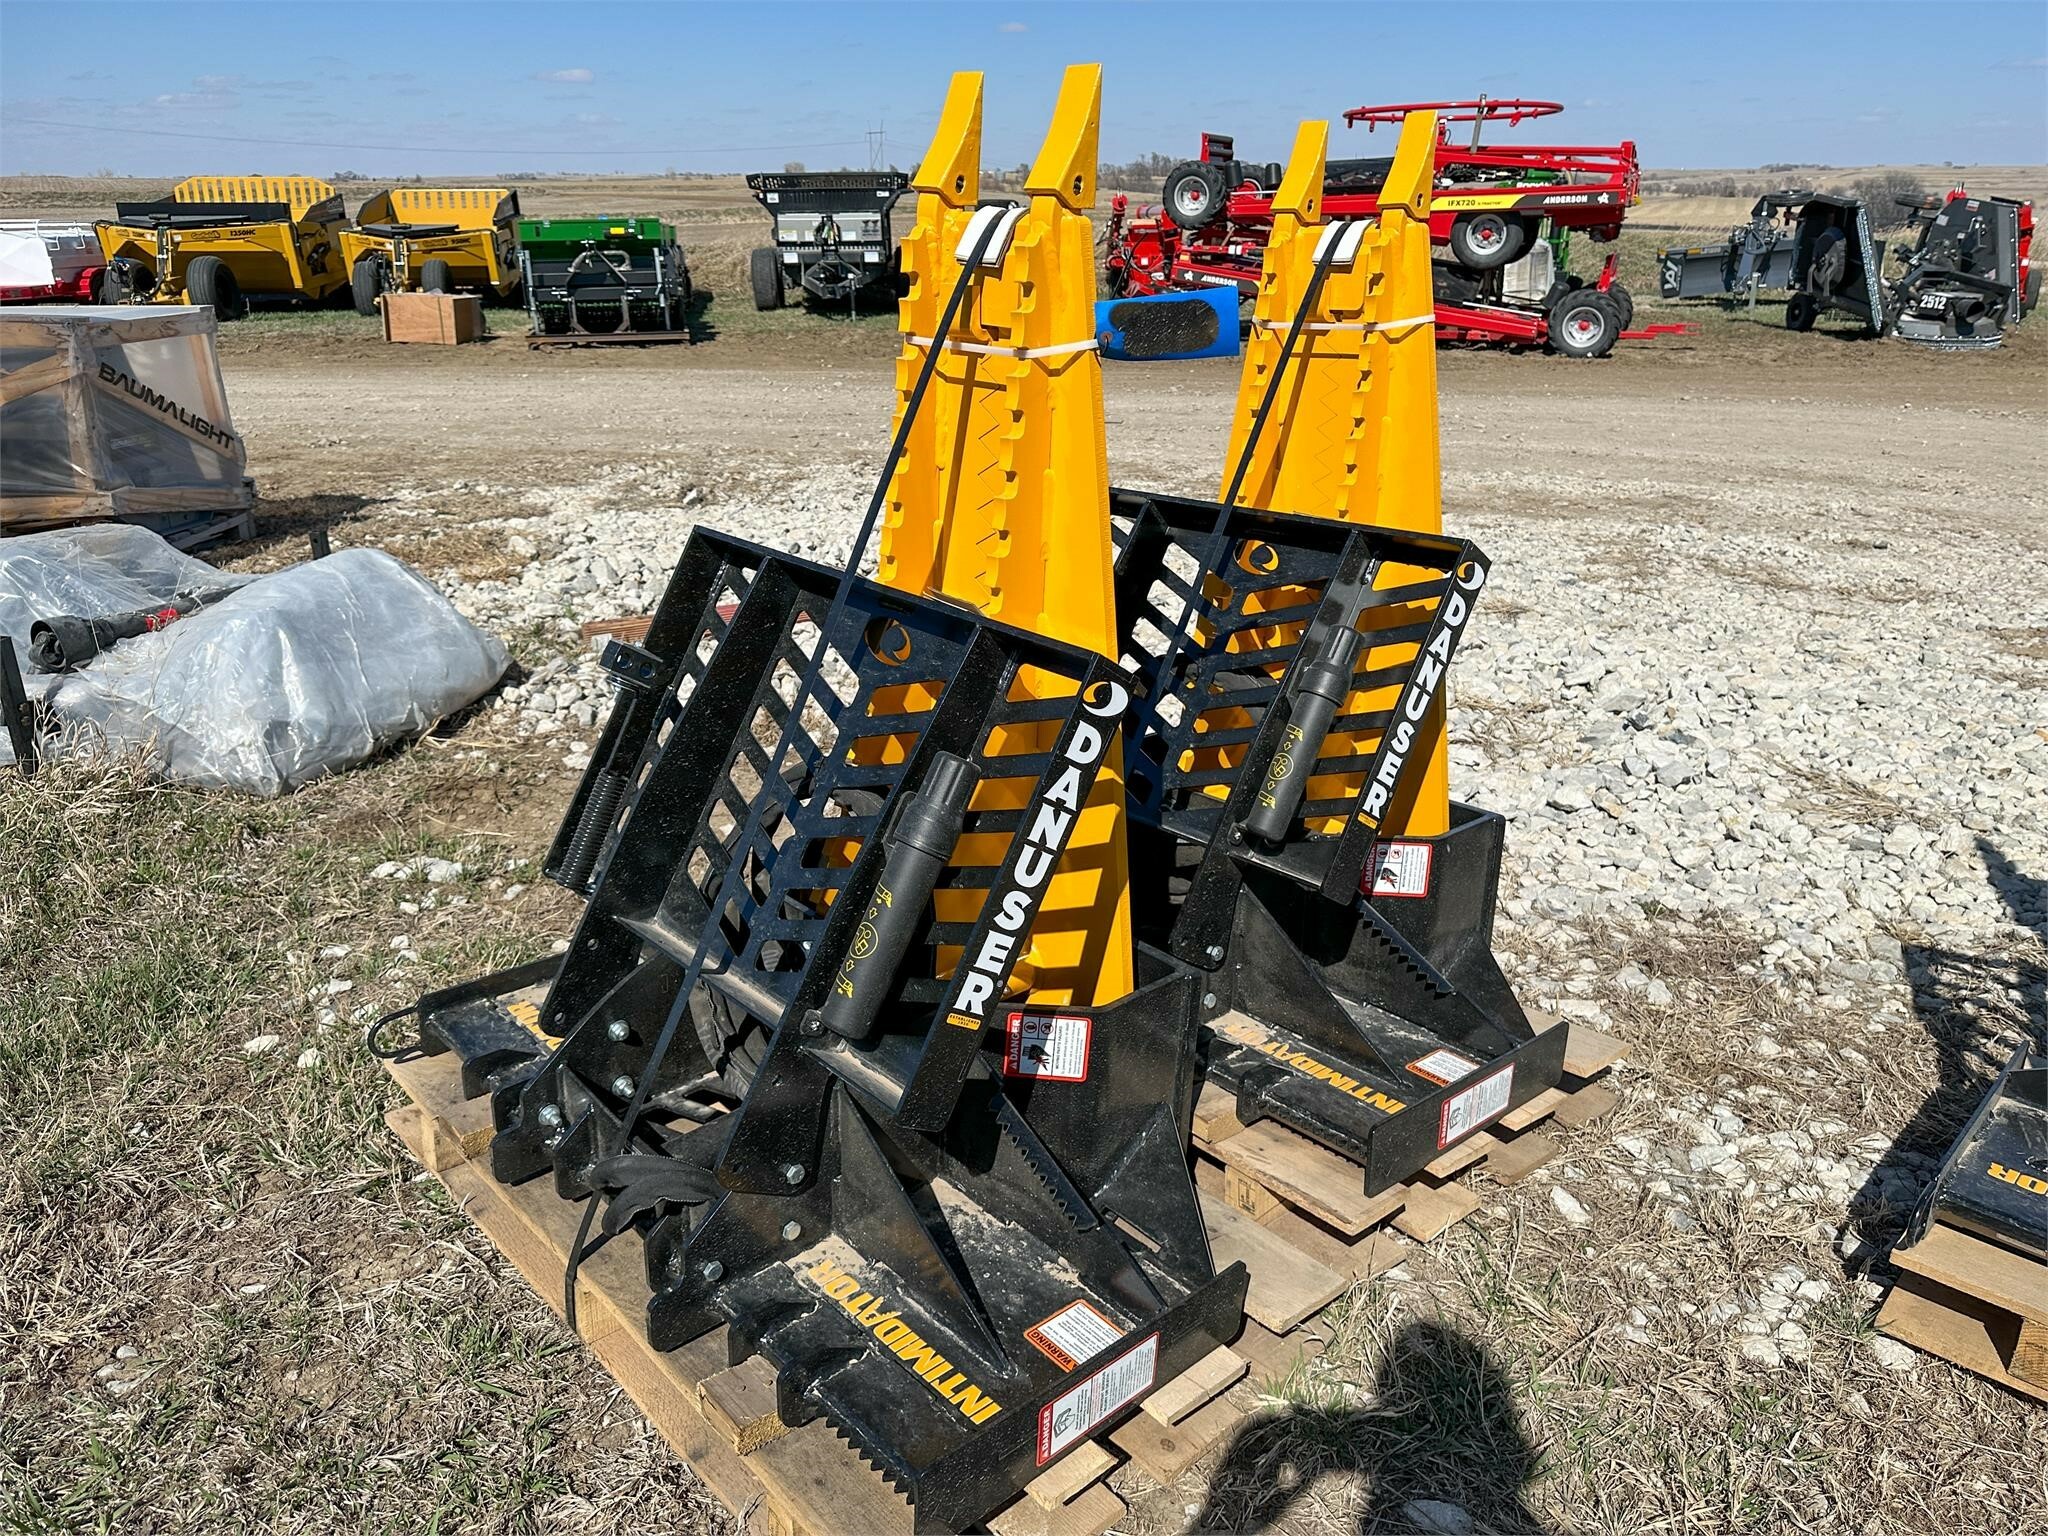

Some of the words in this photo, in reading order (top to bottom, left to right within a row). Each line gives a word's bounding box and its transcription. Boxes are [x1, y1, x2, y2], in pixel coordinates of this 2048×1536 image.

[1543, 195, 1588, 204] ANDERSON
[1201, 275, 1238, 286] ANDERSON
[1920, 294, 1947, 310] 2512
[98, 362, 234, 449] BAUMALIGHT
[1362, 591, 1467, 819] DANUSER
[953, 720, 1102, 1015] DANUSER
[1010, 1019, 1022, 1061] DANGER
[808, 1258, 1003, 1425] INTIMIDATOR
[1031, 1331, 1072, 1366] WARNING
[1041, 1408, 1051, 1449] DANGER
